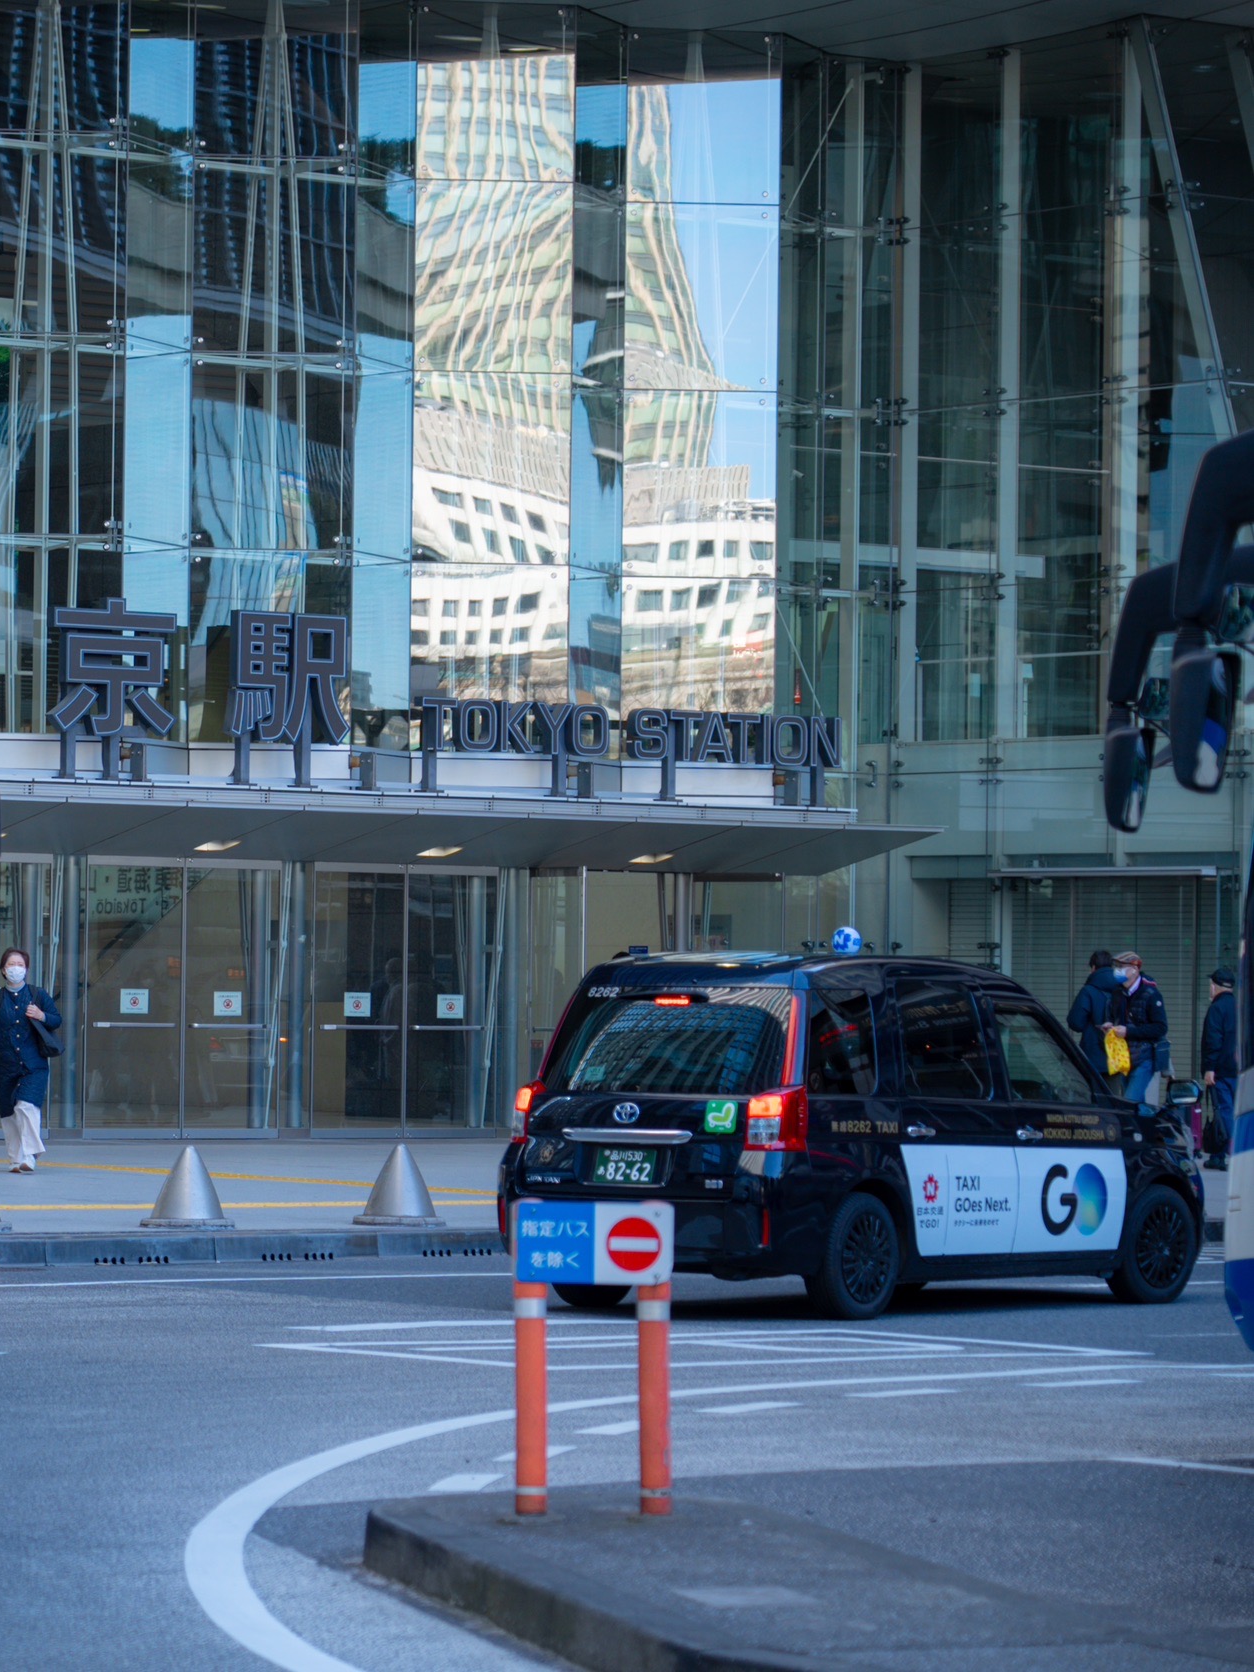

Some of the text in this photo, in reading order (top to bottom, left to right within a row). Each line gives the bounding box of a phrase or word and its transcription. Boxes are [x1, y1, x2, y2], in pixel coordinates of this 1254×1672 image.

[421, 697, 843, 768] TOKYO STATION
[588, 986, 619, 998] 8262
[876, 1121, 899, 1133] TAXI
[606, 1162, 651, 1182] 82-62
[955, 1175, 981, 1192] TAXI
[954, 1197, 1011, 1213] GOes Next.
[531, 1251, 580, 1269] を除く
